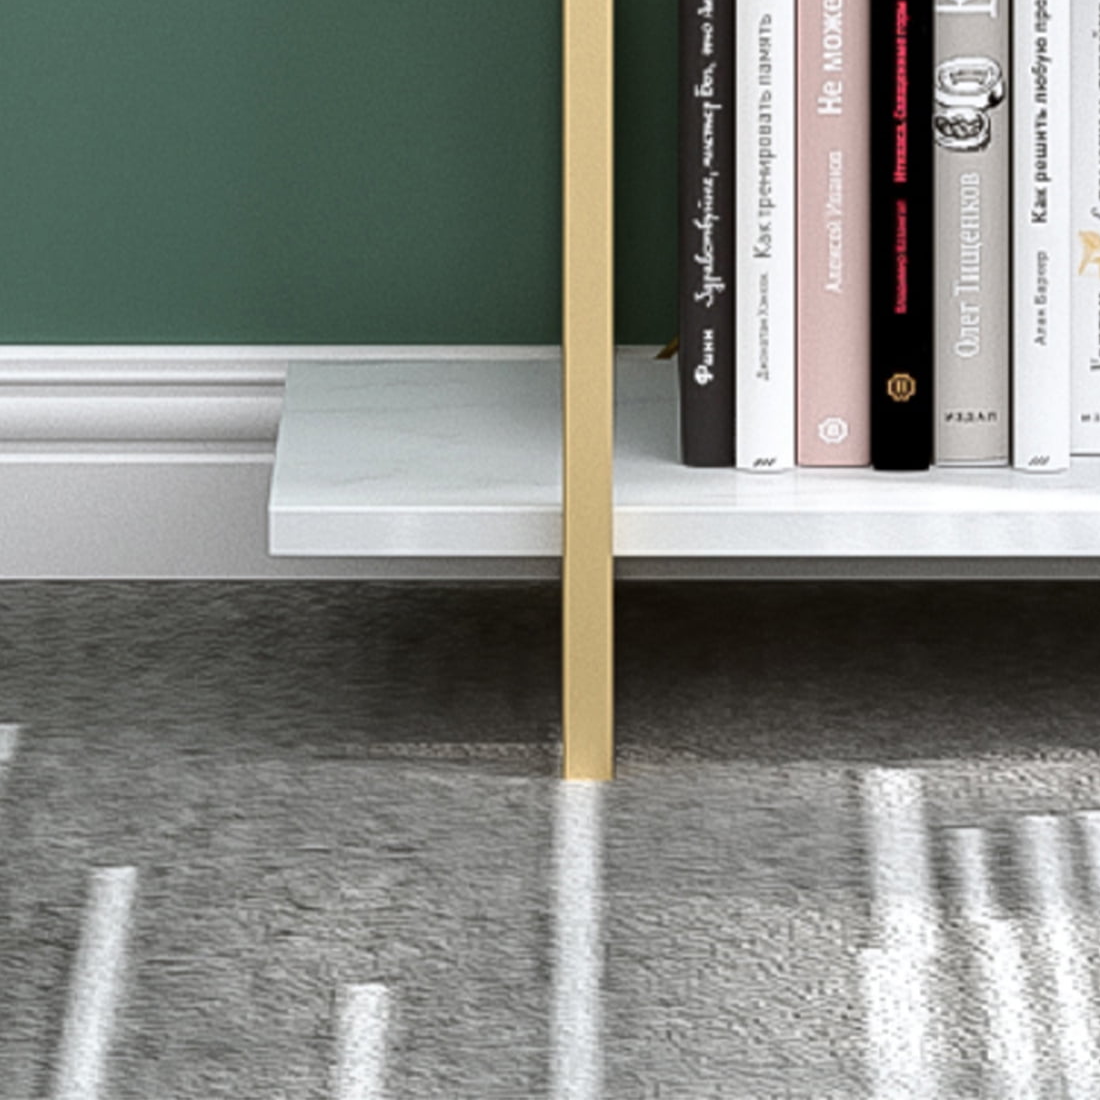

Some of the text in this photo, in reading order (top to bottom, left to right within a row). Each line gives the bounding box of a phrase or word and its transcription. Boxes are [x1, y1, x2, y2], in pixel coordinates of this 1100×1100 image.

[816, 80, 843, 116] Не
[1031, 37, 1053, 105] любую
[753, 13, 778, 259] Как тренировать память
[1034, 108, 1052, 183] решить
[823, 150, 844, 294] Алексей Иванов
[1030, 189, 1050, 224] Как
[953, 172, 983, 357] Олег Тищенков
[694, 328, 715, 386] Финн
